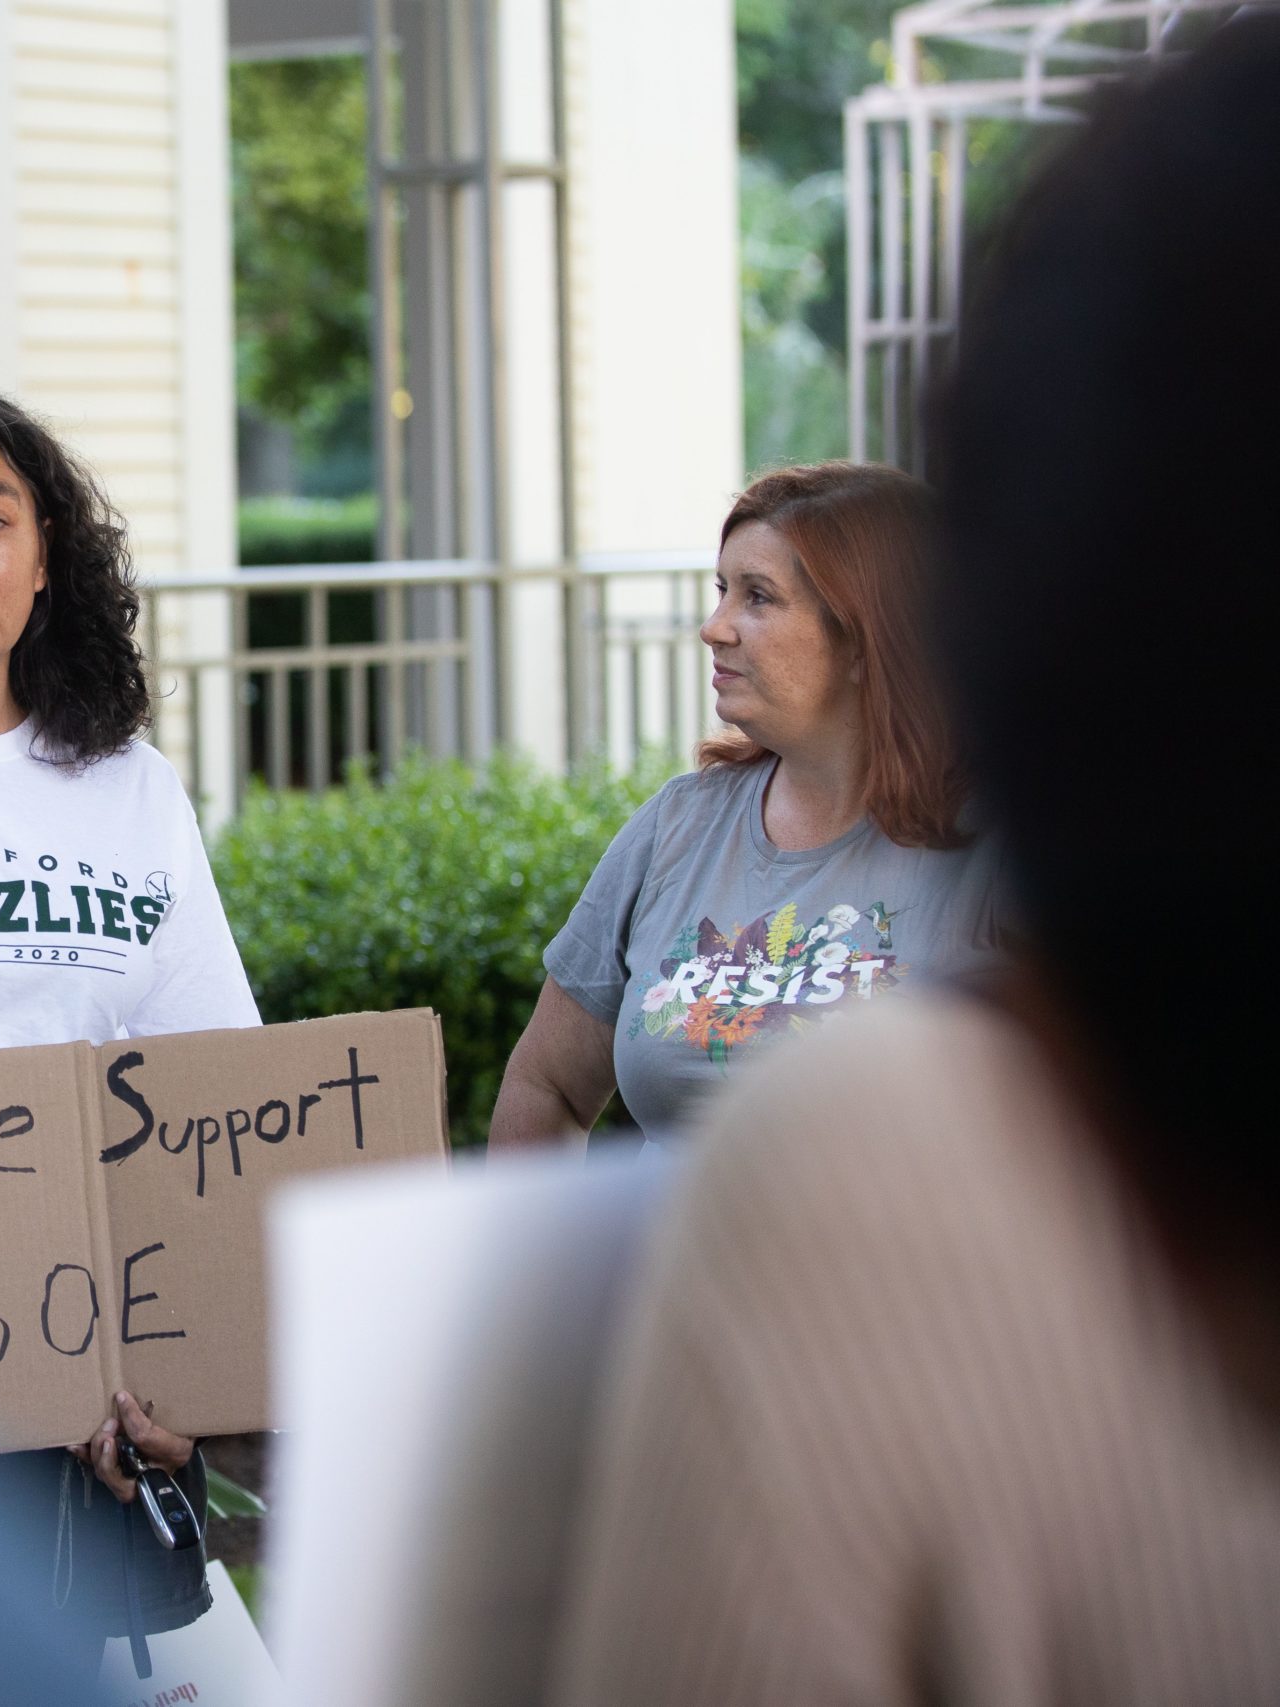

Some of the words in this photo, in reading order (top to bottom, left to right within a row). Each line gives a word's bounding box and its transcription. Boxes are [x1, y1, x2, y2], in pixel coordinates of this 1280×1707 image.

[13, 948, 80, 963] 2020
[669, 959, 885, 1005] RESIST
[99, 1046, 380, 1198] Support
